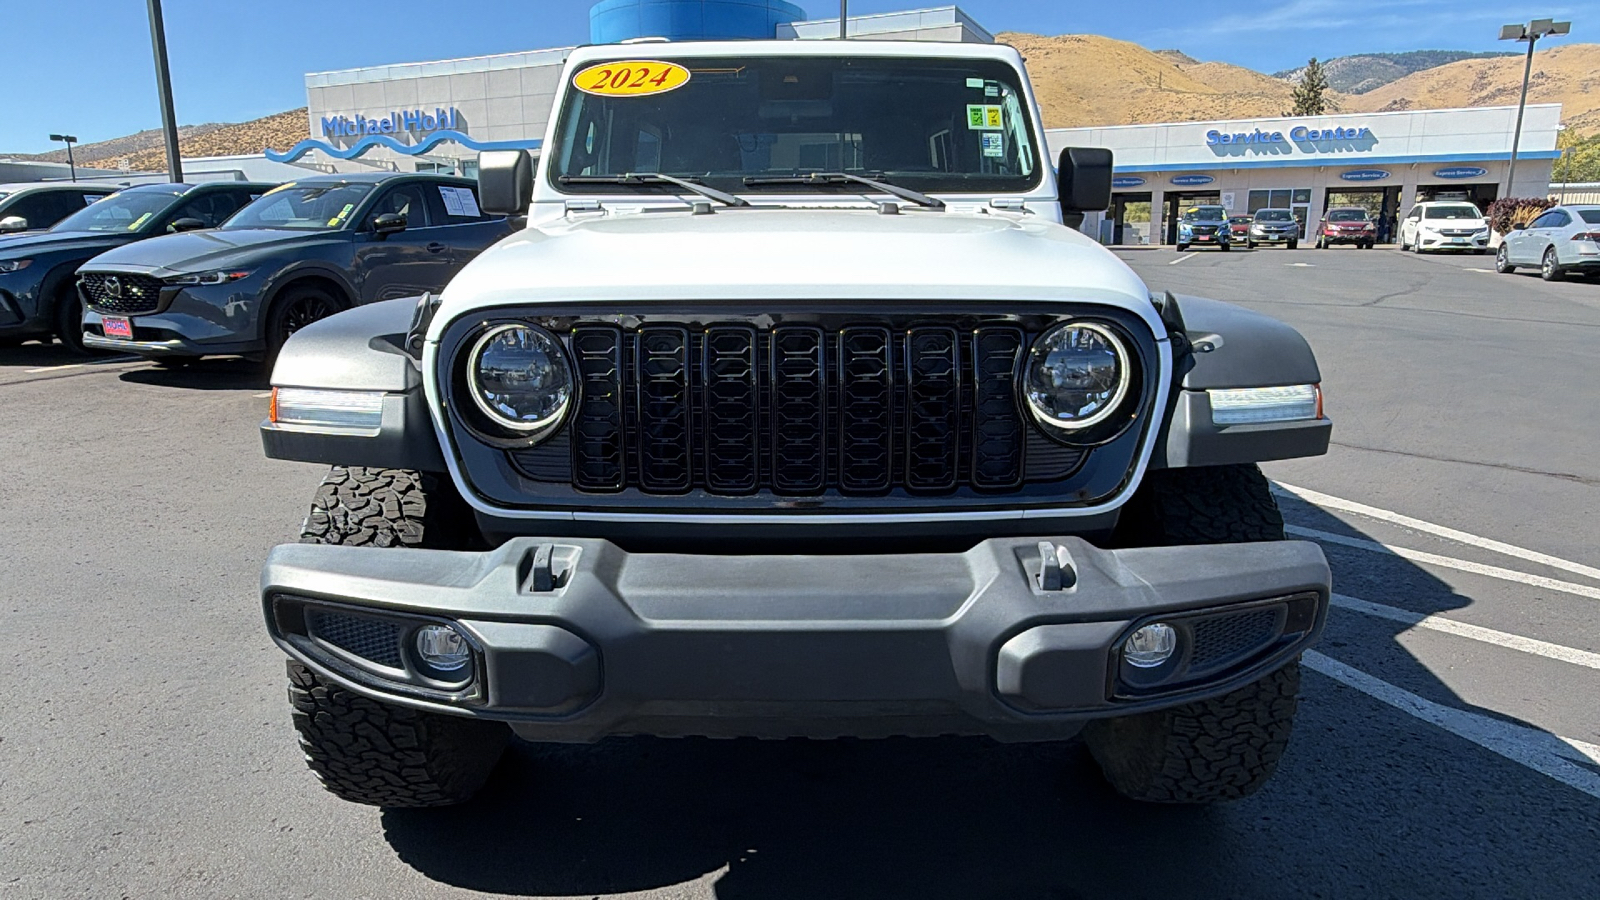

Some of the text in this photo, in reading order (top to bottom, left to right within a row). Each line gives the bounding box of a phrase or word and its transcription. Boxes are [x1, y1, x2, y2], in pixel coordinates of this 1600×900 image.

[589, 66, 673, 89] 2024
[321, 106, 457, 136] Michael Hohl
[1206, 125, 1369, 145] Service Center
